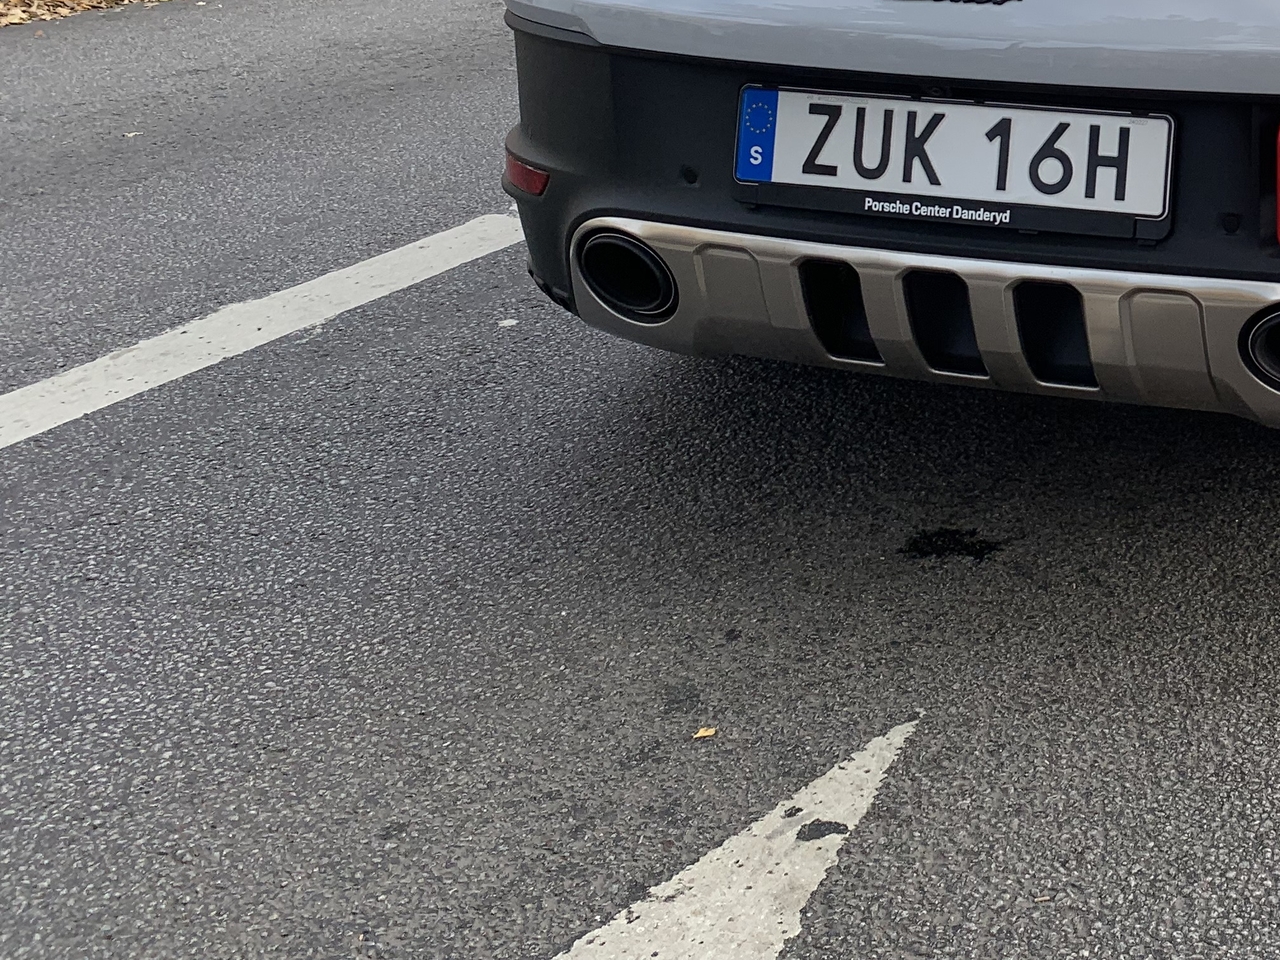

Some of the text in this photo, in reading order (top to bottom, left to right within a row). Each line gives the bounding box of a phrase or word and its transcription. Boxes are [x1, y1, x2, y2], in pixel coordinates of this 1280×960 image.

[749, 145, 764, 166] S
[801, 102, 1132, 202] ZUK 16H
[864, 197, 1011, 224] Porsche Center Danderyd
